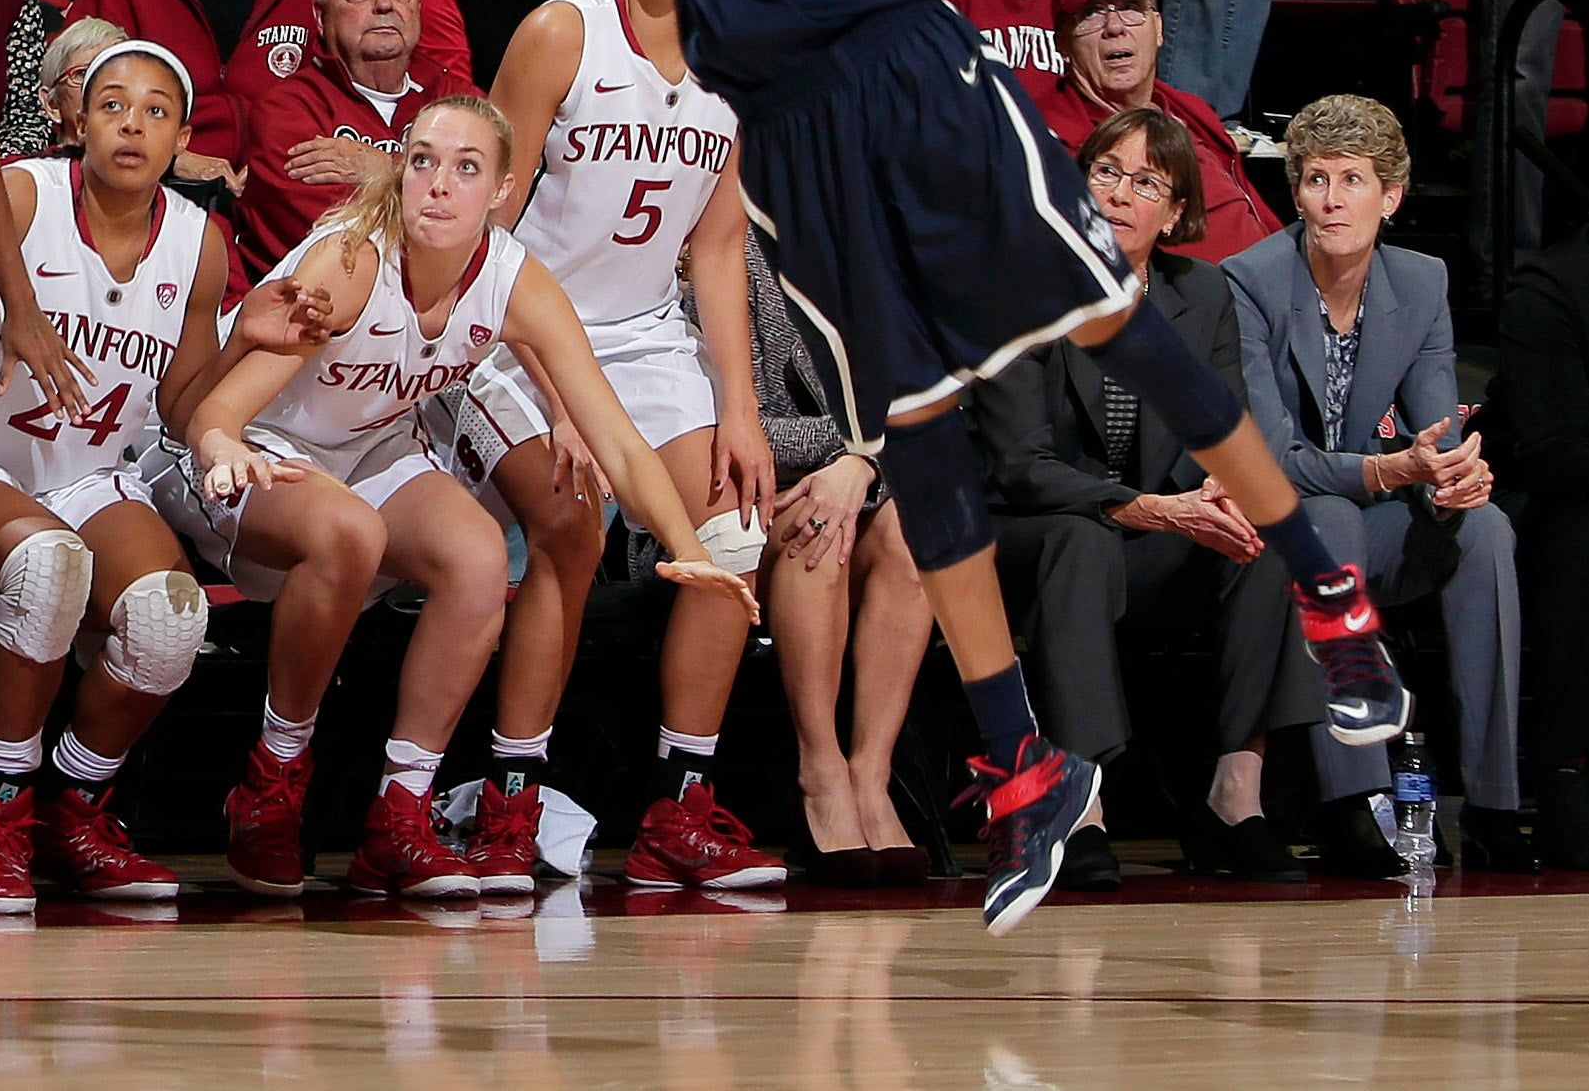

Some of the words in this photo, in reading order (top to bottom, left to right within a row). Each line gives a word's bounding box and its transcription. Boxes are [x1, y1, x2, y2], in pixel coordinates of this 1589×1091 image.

[257, 25, 309, 48] STANFO
[562, 123, 733, 175] STANFORD
[612, 179, 673, 245] 5
